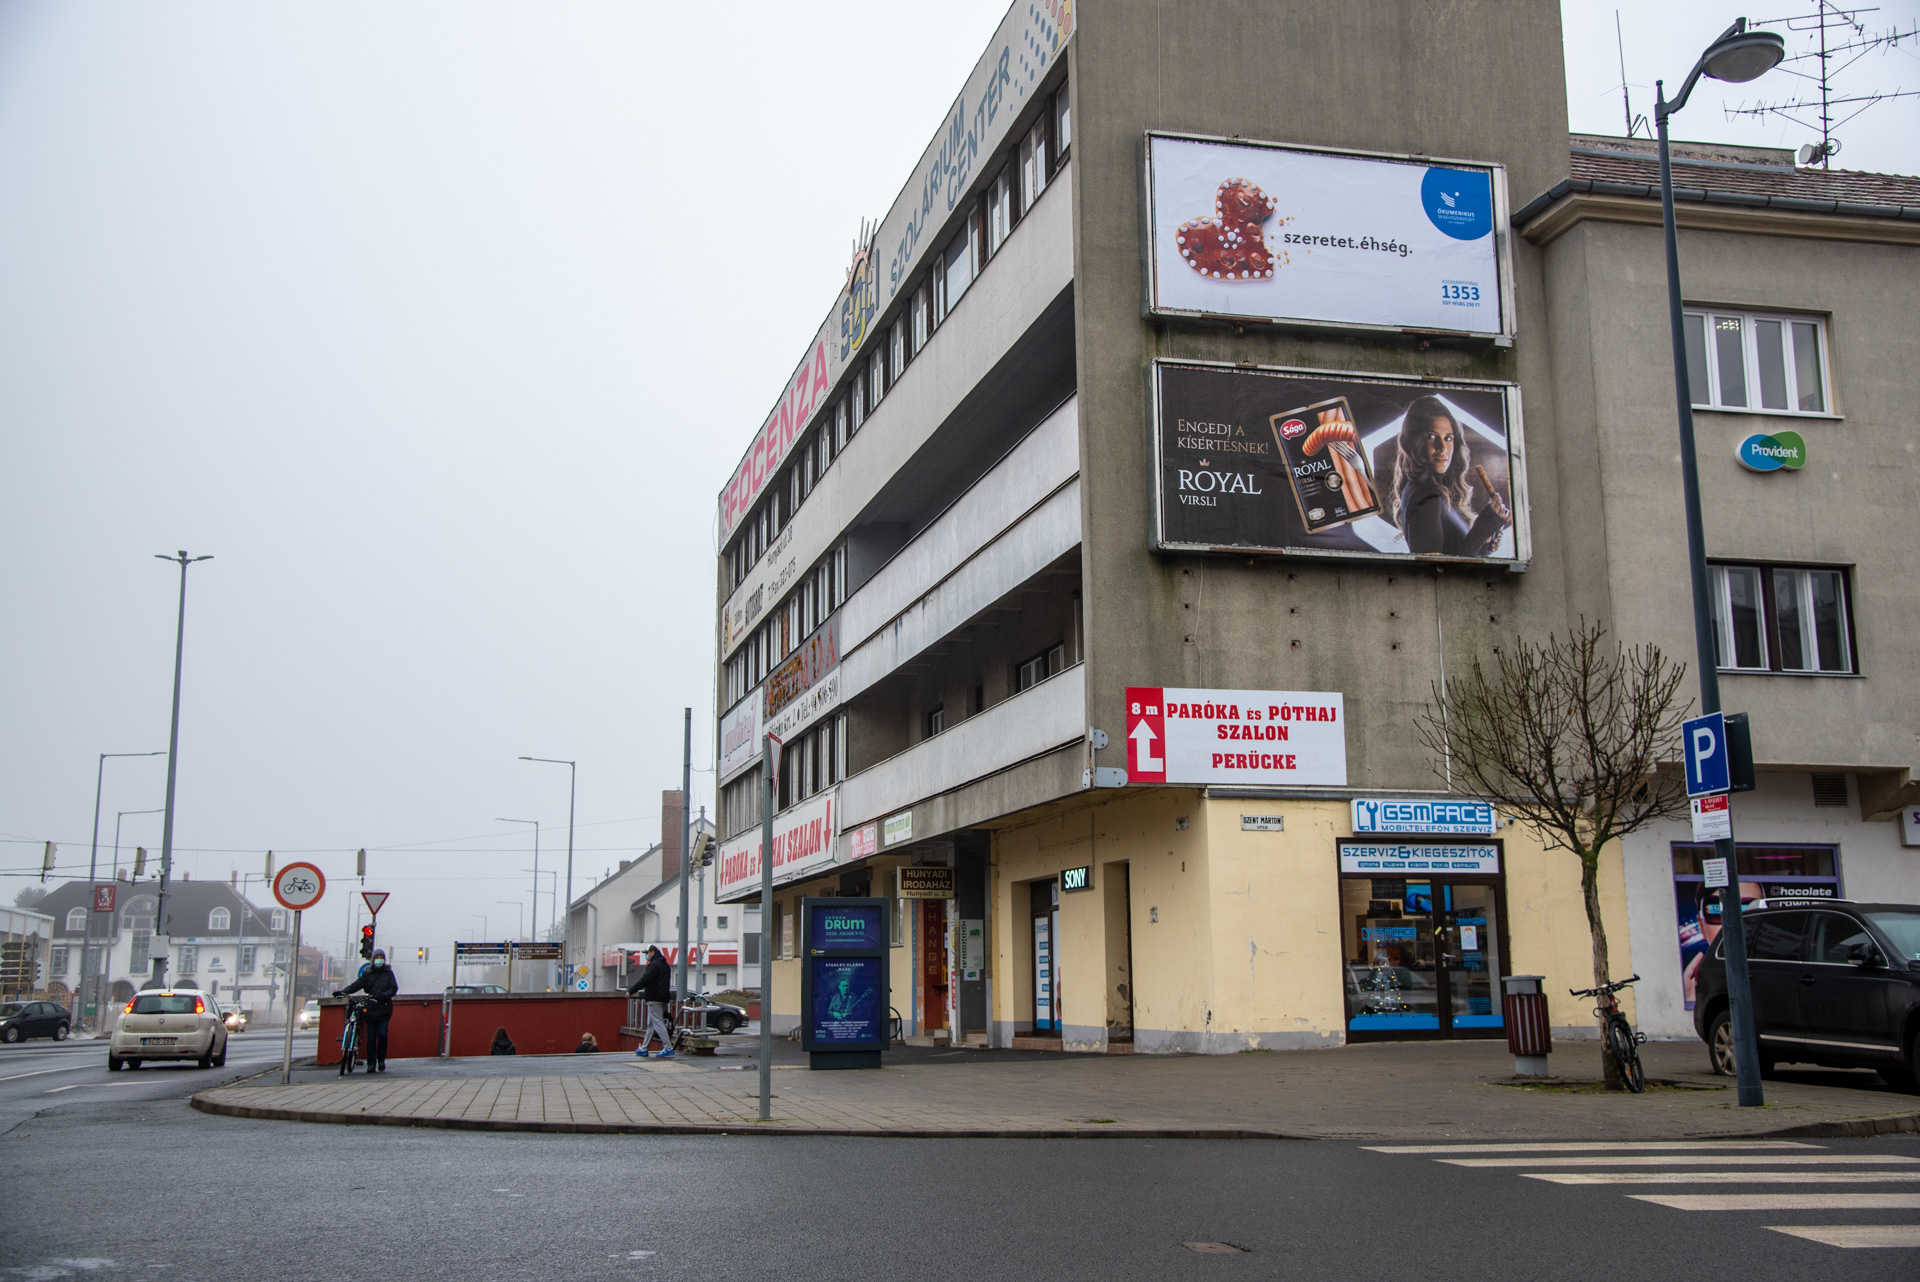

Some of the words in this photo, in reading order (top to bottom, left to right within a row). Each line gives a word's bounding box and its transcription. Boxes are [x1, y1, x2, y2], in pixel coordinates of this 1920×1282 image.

[947, 46, 1011, 212] CENTER
[890, 97, 965, 297] SZOLÁRIUM
[1284, 233, 1413, 257] szeretet.éhség.
[1442, 285, 1480, 300] 1353
[1178, 418, 1231, 436] ENGEDJ
[1235, 425, 1245, 436] A
[1178, 434, 1269, 454] KÍSÉRTÉSNEK!
[1751, 443, 1798, 458] Provident
[1293, 459, 1332, 478] ROYAL
[1178, 469, 1262, 495] ROYAL
[1180, 494, 1217, 507] VIRSLI
[1131, 702, 1141, 715] 8
[1145, 705, 1158, 715] m
[1167, 700, 1240, 720] PARÓKA
[1247, 707, 1261, 721] ÉS
[1269, 702, 1337, 722] PÓTHAJ
[1217, 724, 1289, 741] SZALON
[1212, 750, 1297, 770] PERÜCKE
[1693, 727, 1716, 784] P
[1383, 804, 1492, 823] GSMFACE
[1381, 823, 1450, 832] MOBILTELEFON
[1453, 825, 1492, 833] SZERVIZ
[787, 816, 822, 863] SZALON
[906, 870, 948, 878] HUNYADI
[1065, 868, 1086, 889] SONY
